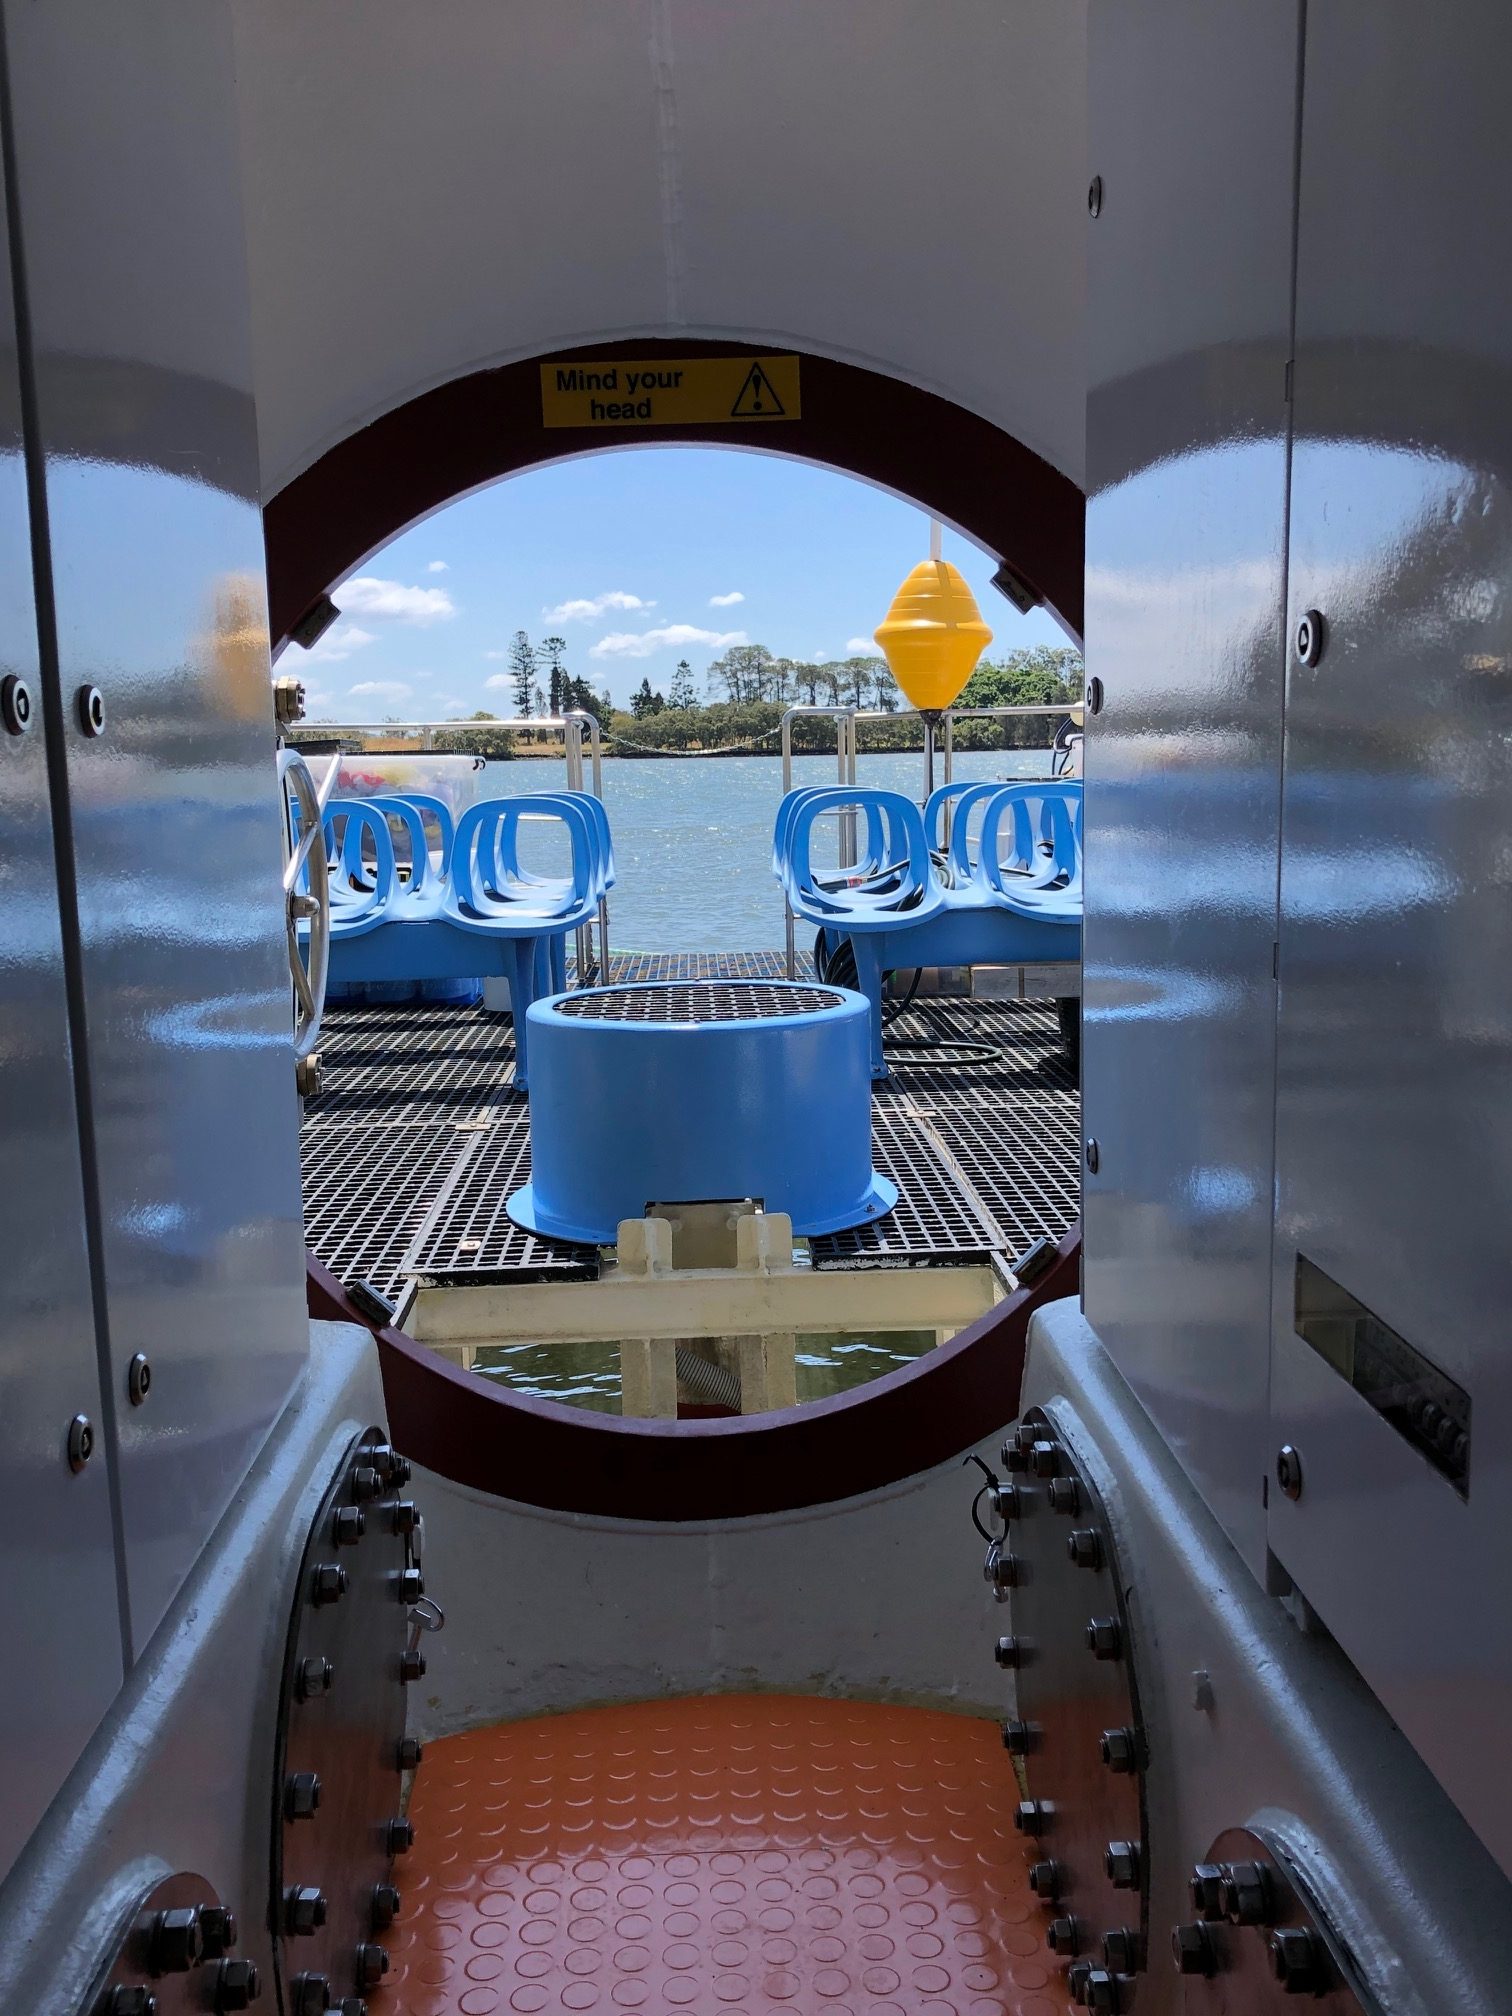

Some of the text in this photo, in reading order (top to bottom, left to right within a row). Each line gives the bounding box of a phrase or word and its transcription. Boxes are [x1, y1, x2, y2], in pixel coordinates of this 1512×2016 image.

[556, 369, 683, 394] Mind your
[590, 398, 651, 420] head
